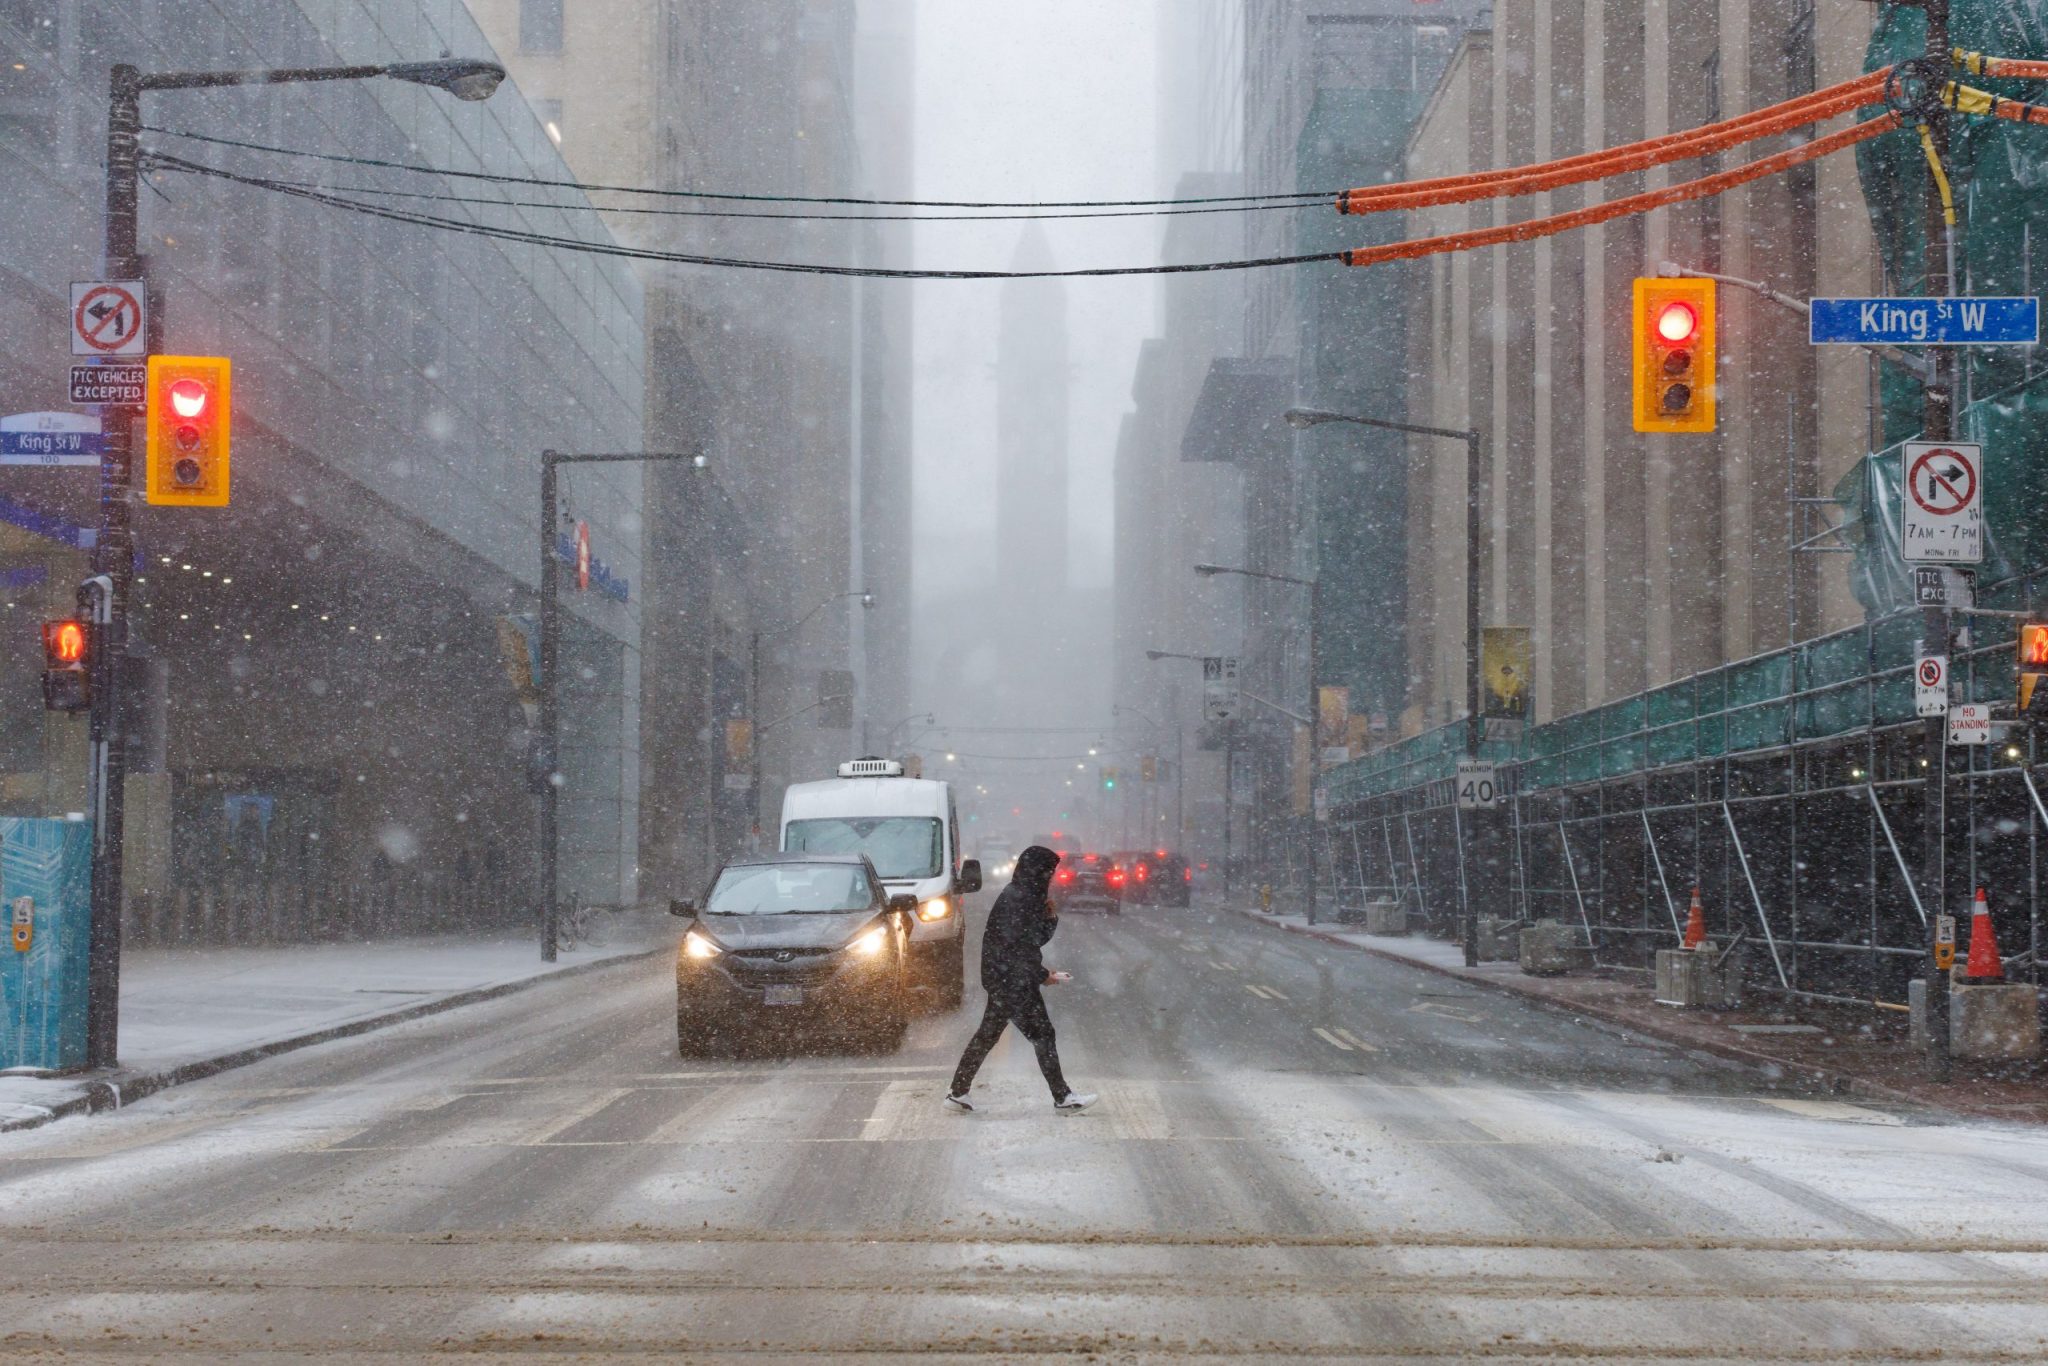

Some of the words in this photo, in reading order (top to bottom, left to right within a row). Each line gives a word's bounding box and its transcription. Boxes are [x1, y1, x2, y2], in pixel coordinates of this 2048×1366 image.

[1860, 302, 1928, 340] King
[1937, 303, 1953, 319] St
[1960, 302, 1987, 332] W
[97, 371, 144, 384] VEHICLES
[75, 386, 141, 398] EXCEPTED
[20, 434, 51, 453] King
[56, 437, 66, 449] St
[69, 434, 81, 450] W
[40, 455, 60, 464] 100
[1948, 549, 1960, 557] FRI
[1918, 571, 1938, 585] TTC
[1962, 707, 1976, 718] NO
[1950, 719, 1989, 730] STANDING
[1459, 765, 1492, 773] MAXIMUM
[1460, 780, 1494, 802] 40
